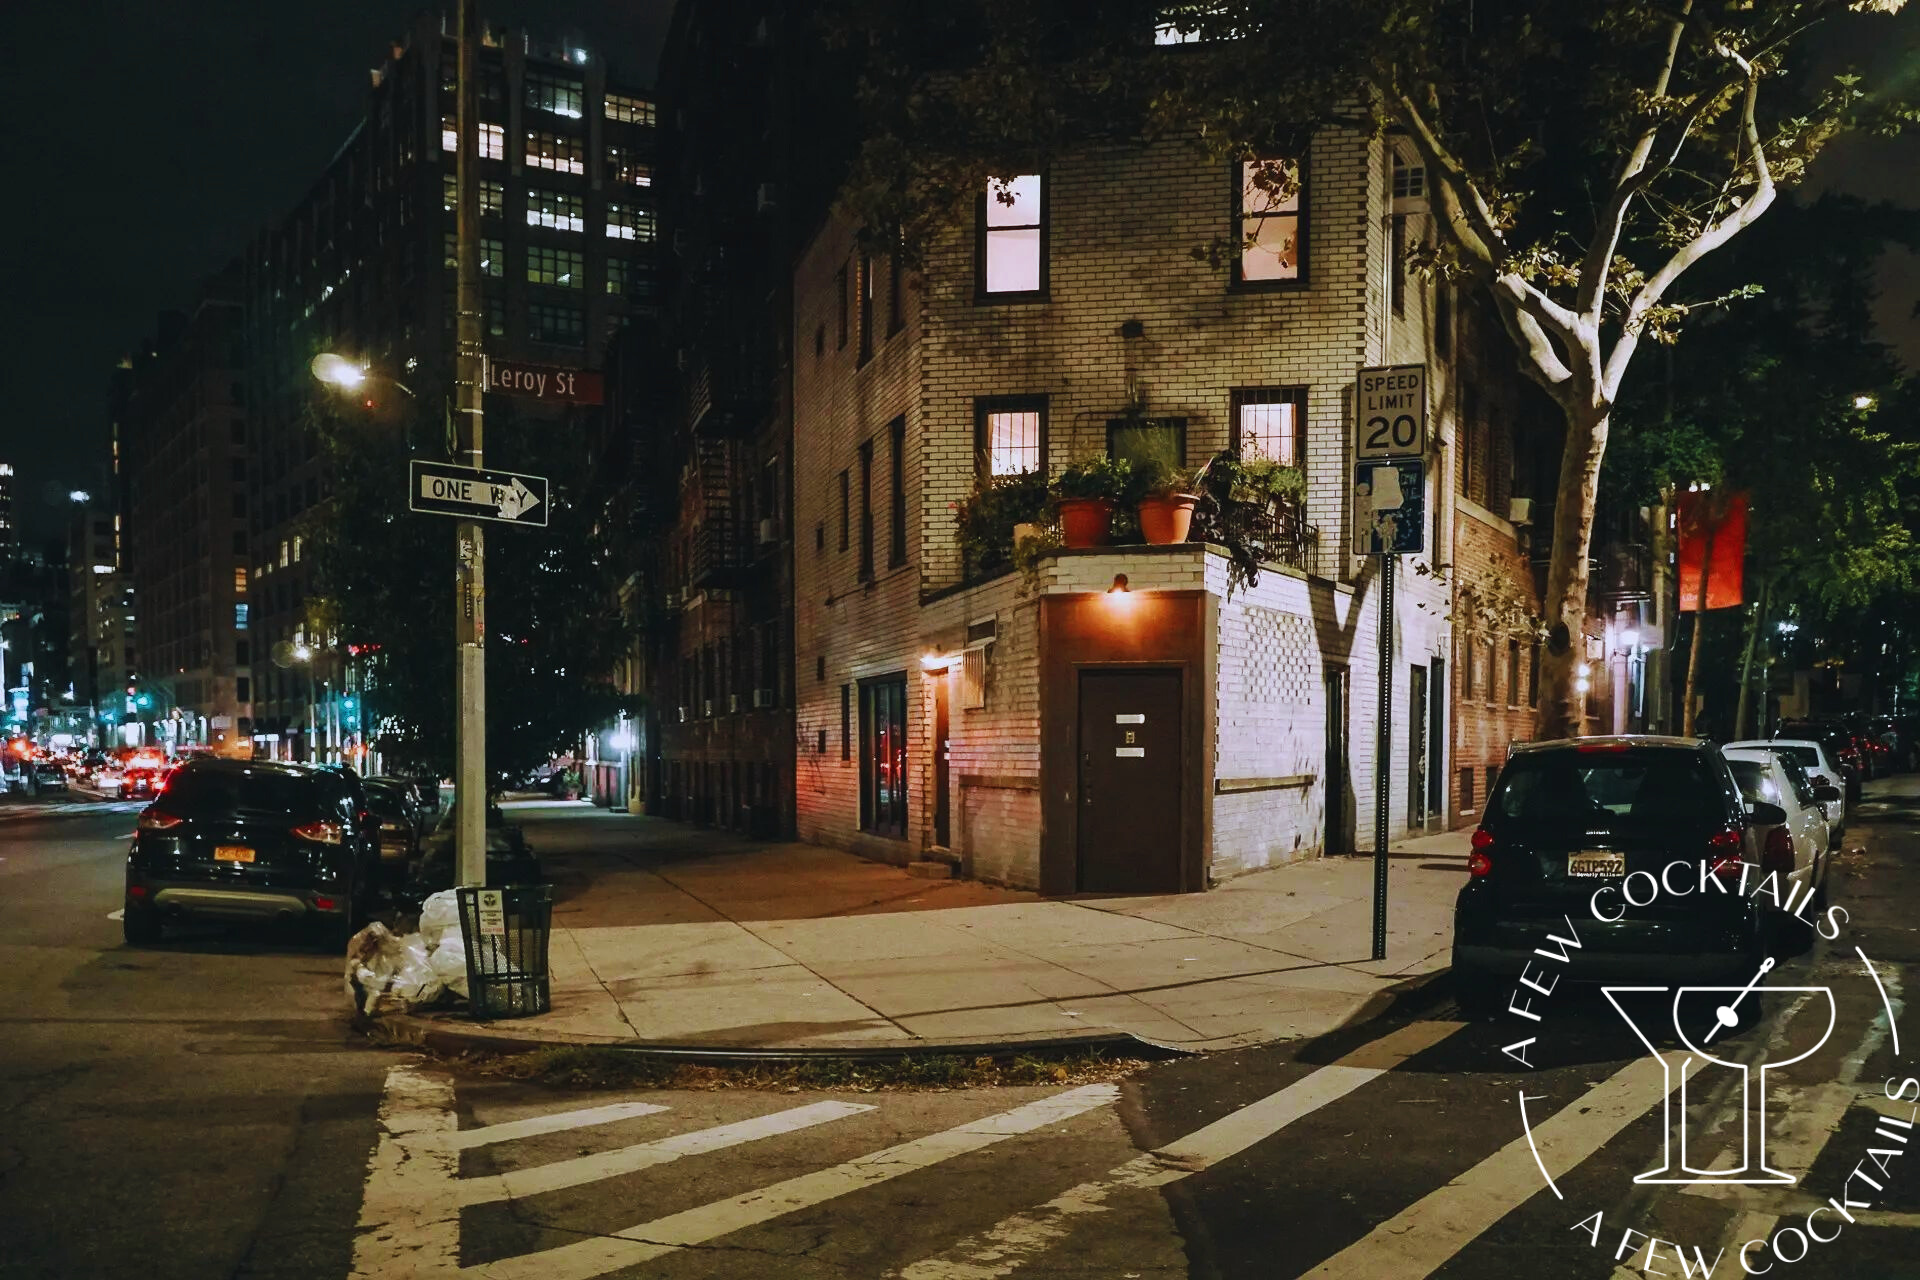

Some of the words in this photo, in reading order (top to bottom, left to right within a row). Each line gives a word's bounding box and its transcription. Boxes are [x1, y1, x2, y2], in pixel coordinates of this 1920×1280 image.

[491, 364, 547, 397] Leroy
[556, 371, 576, 396] St
[1364, 374, 1419, 392] SPEED
[1367, 393, 1415, 411] LIMIT
[1365, 414, 1417, 449] 20
[432, 479, 473, 501] ONE
[490, 486, 528, 508] WY
